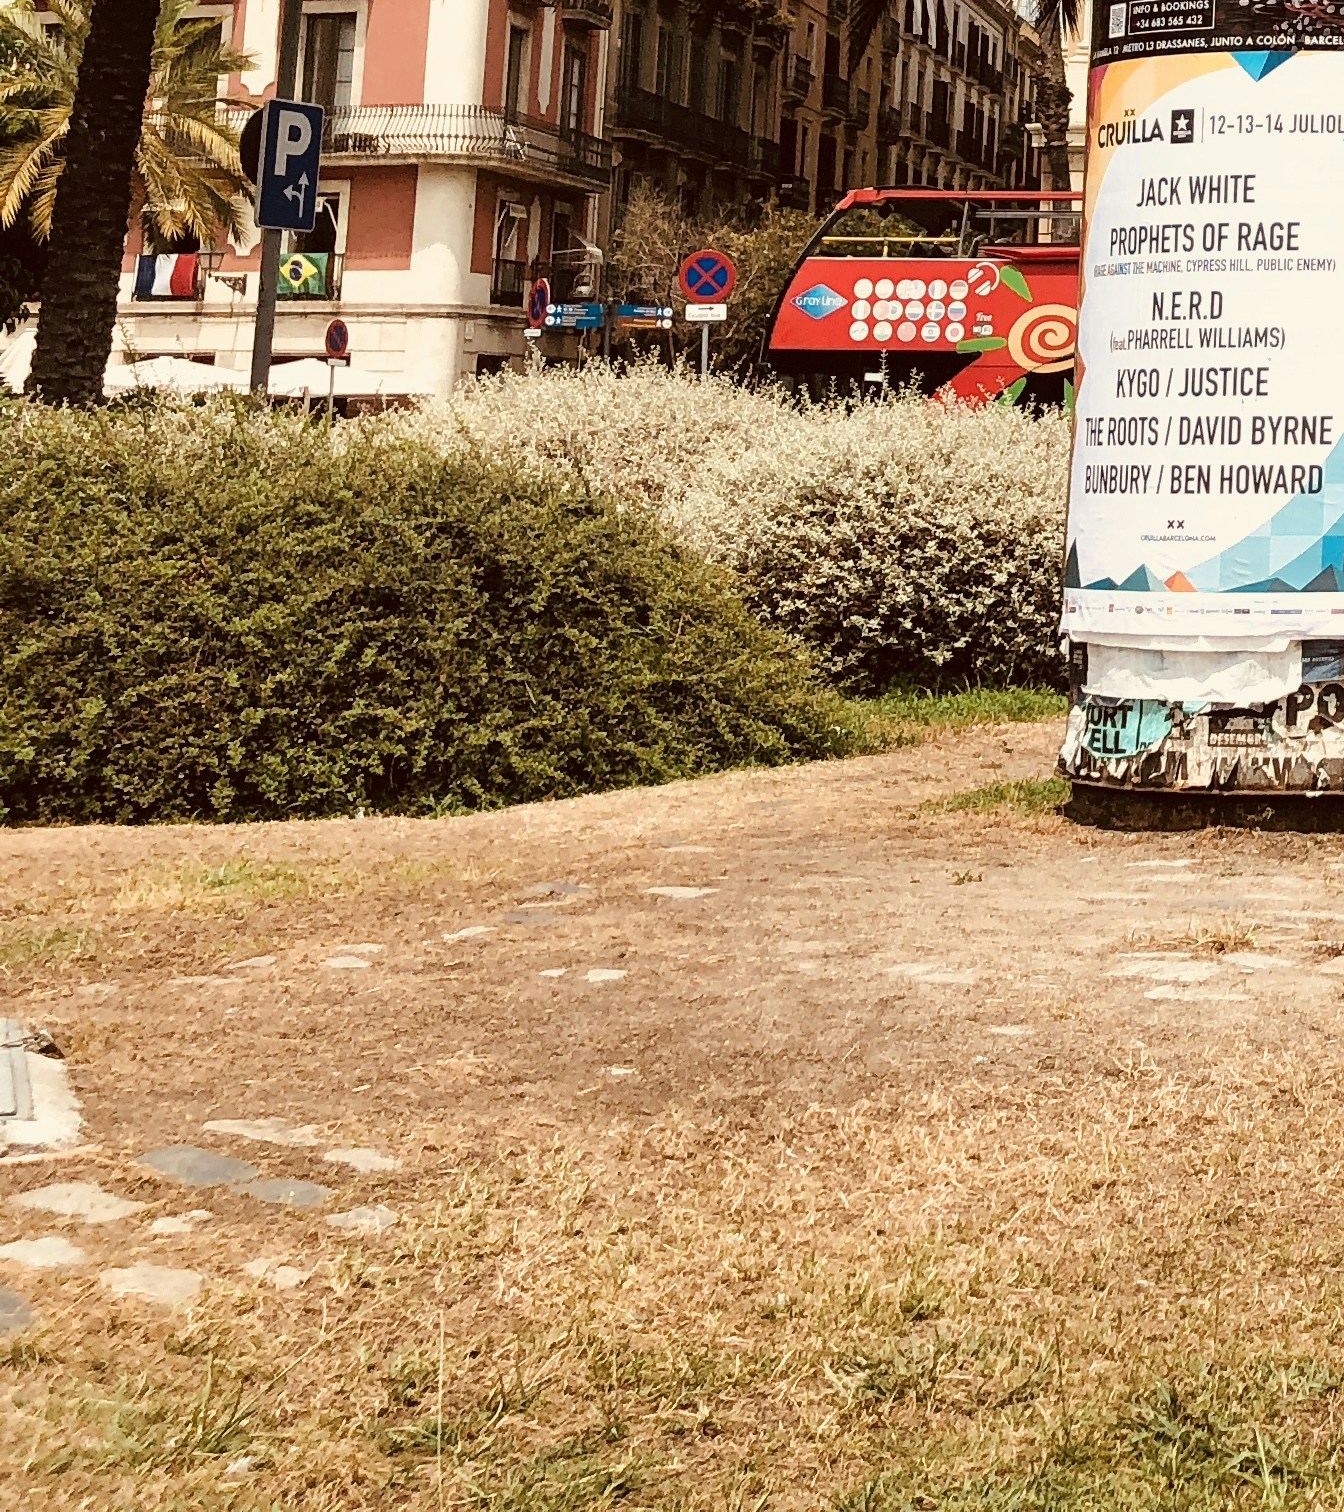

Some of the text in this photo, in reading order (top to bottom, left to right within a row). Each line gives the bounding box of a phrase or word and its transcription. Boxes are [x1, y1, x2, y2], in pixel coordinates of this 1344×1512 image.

[1133, 0, 1209, 14] INFO & BOOKINGS
[1168, 16, 1183, 26] 565
[1186, 14, 1203, 25] 432
[1146, 41, 1154, 51] L3
[1157, 38, 1208, 50] DRASSANES,
[1210, 36, 1243, 47] JUNTO
[1246, 36, 1254, 45] A
[1256, 33, 1296, 45] COLÓN
[1209, 114, 1283, 135] 12-13-14
[273, 111, 312, 176] P
[1136, 174, 1256, 208] JACK WHITE
[1110, 221, 1300, 257] PROPHETS OF RAGE
[1132, 261, 1145, 275] THE
[1186, 258, 1227, 273] CYPRESS
[1256, 258, 1294, 272] PUBLIC
[1296, 258, 1337, 273] ENEMY)
[1151, 290, 1223, 321] N.E.R.D
[1128, 328, 1193, 350] PHARRELL
[1199, 326, 1286, 350] WILLIAMS)
[1116, 368, 1160, 398] KYGO
[1178, 367, 1269, 397] JUSTICE
[1085, 417, 1103, 446] THE
[1107, 416, 1159, 446] ROOTS
[1179, 416, 1242, 445] DAVID
[1251, 416, 1333, 445] BYRNE
[1085, 465, 1152, 494] BUNBURY
[1170, 464, 1211, 494] BEN
[1219, 464, 1323, 494] HOWARD
